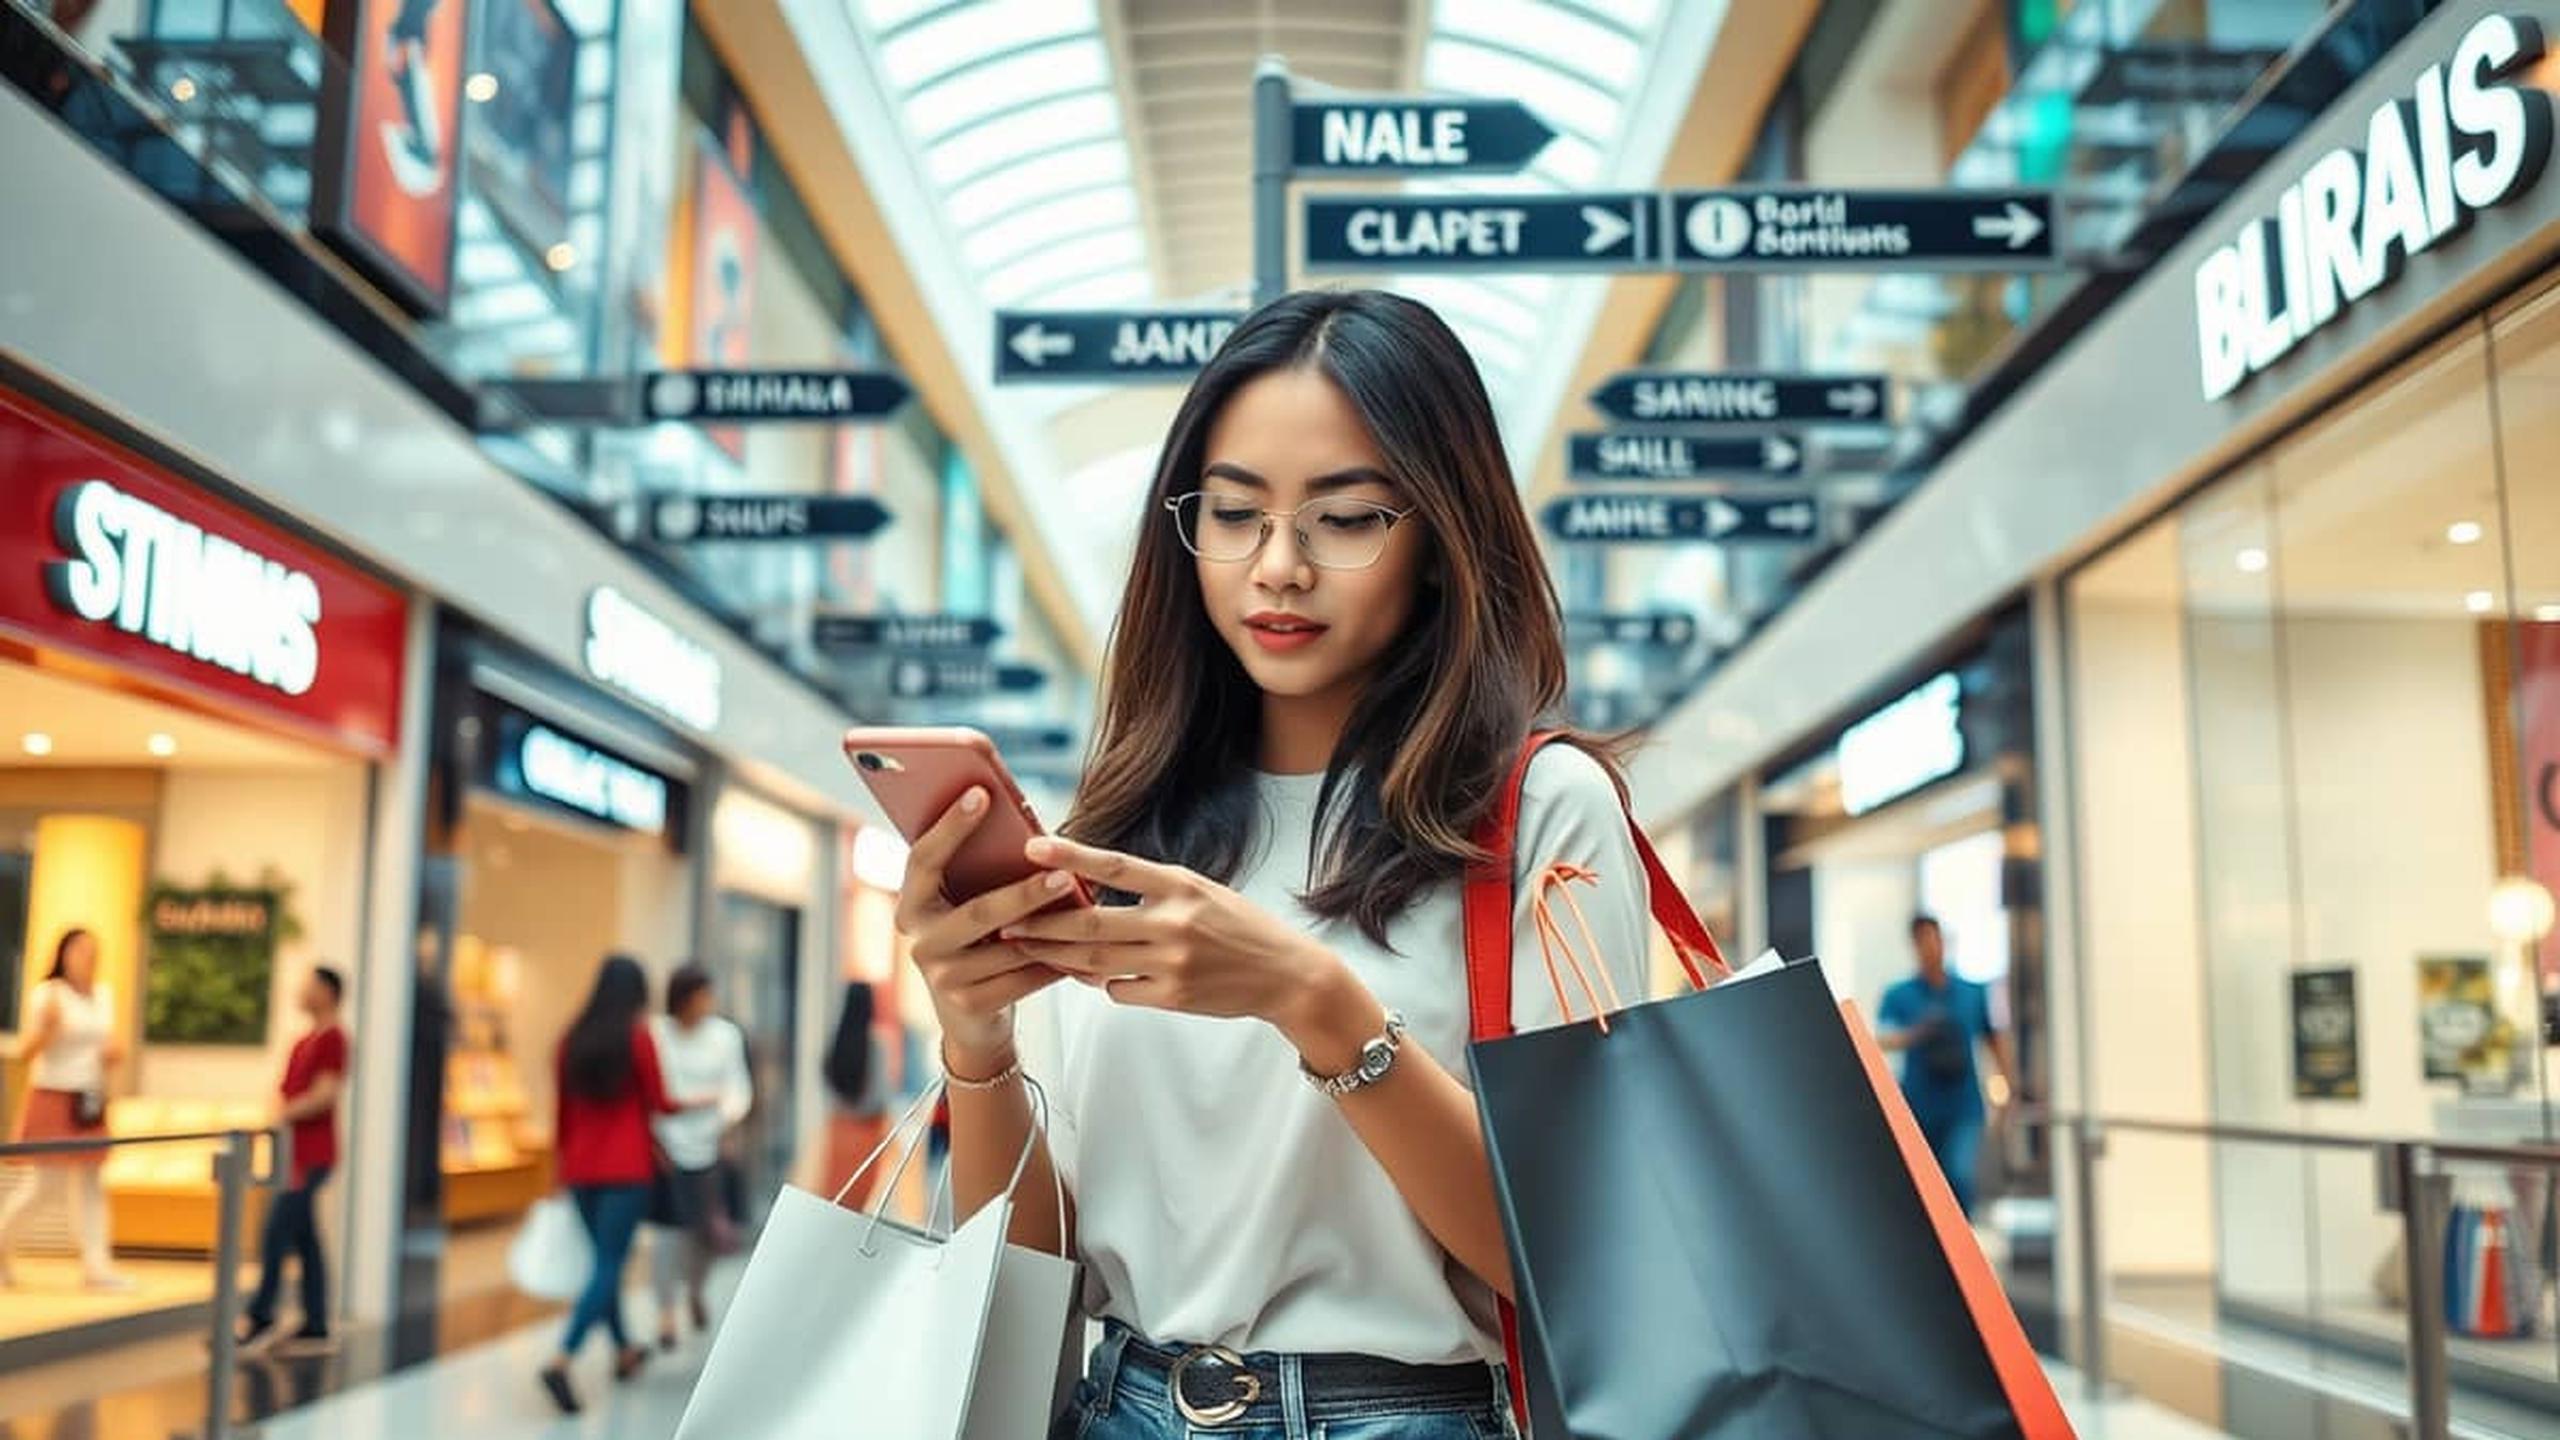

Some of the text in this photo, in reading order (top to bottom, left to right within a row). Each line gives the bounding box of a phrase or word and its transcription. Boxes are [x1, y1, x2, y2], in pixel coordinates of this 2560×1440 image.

[1322, 109, 1469, 164] NALE
[1346, 209, 1526, 255] CLAPET
[2195, 13, 2528, 402] BLIRAIS
